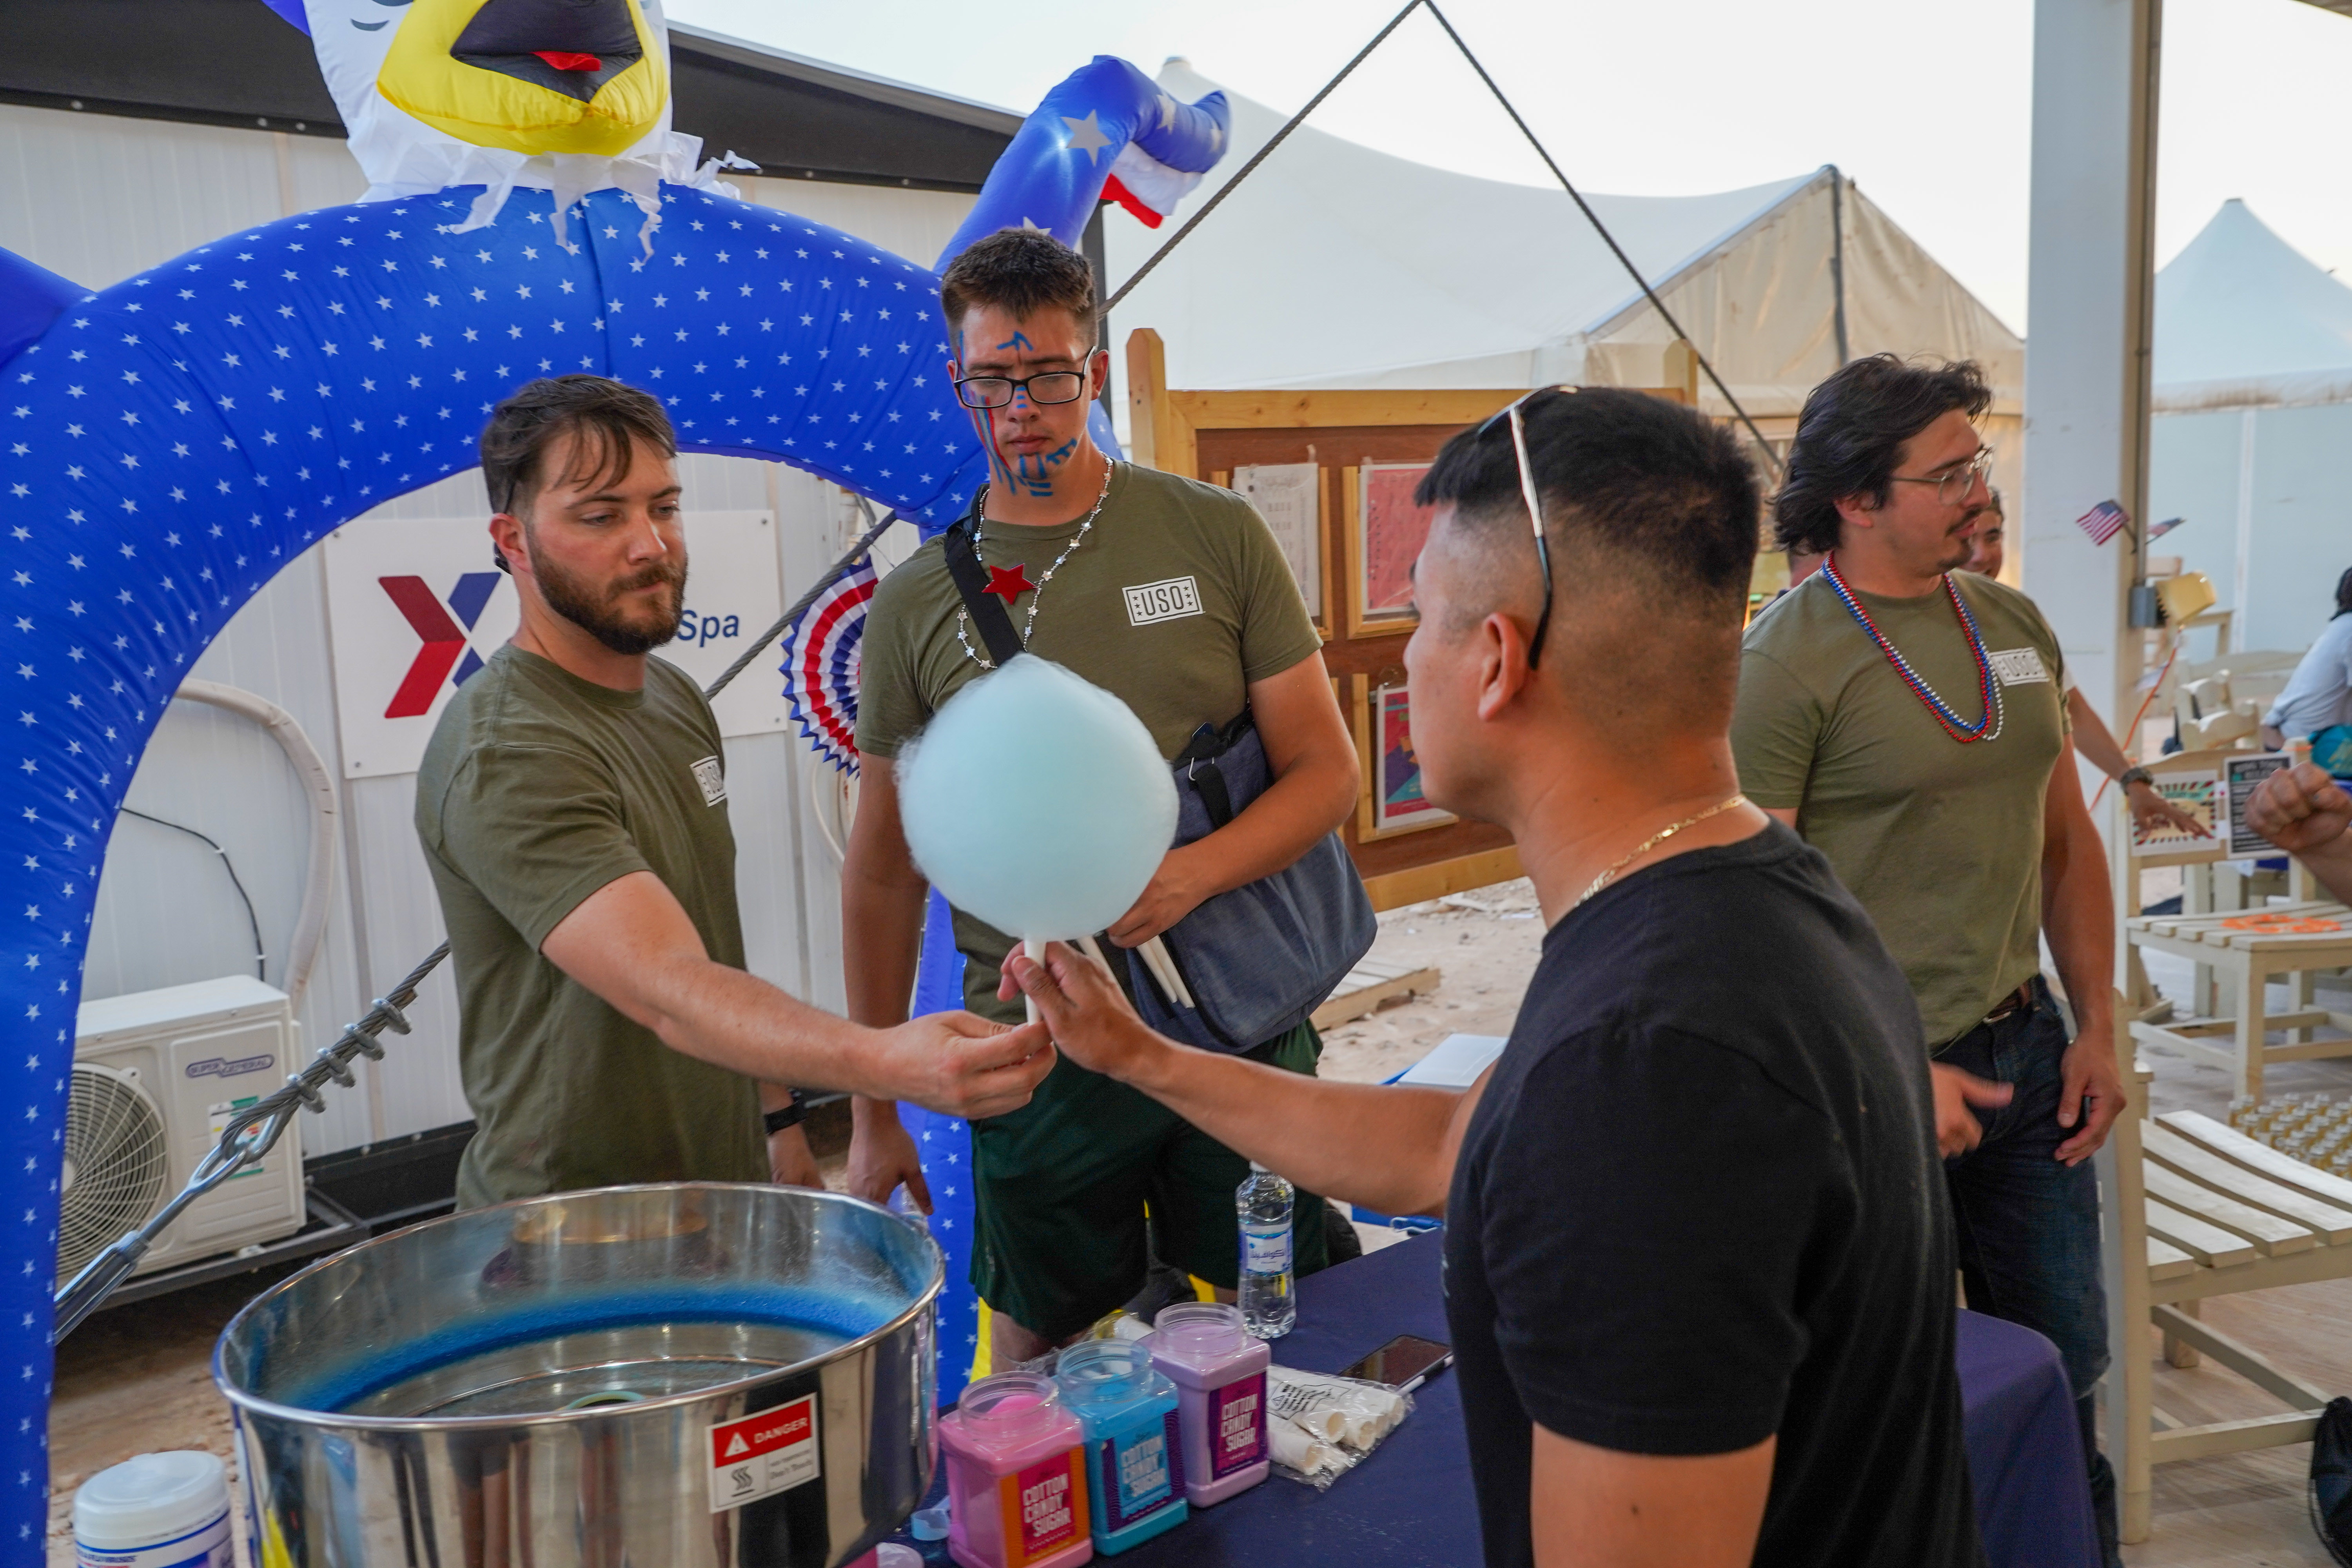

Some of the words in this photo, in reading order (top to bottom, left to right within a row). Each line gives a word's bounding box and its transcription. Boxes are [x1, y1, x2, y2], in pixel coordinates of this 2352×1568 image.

[1140, 585, 1184, 616] USO
[677, 610, 739, 648] Spa
[1221, 1393, 1258, 1421] COTTON
[753, 1417, 809, 1444] DANGER
[1221, 1412, 1253, 1437] CANDY
[1226, 1426, 1256, 1452] SUGAR
[1121, 1435, 1163, 1467] COTTON
[1123, 1453, 1158, 1484] CANDY
[1131, 1468, 1166, 1497] SUGAR
[1022, 1473, 1069, 1506] COTTON
[1024, 1492, 1063, 1523] CANDY
[1032, 1507, 1071, 1537] SUGAR
